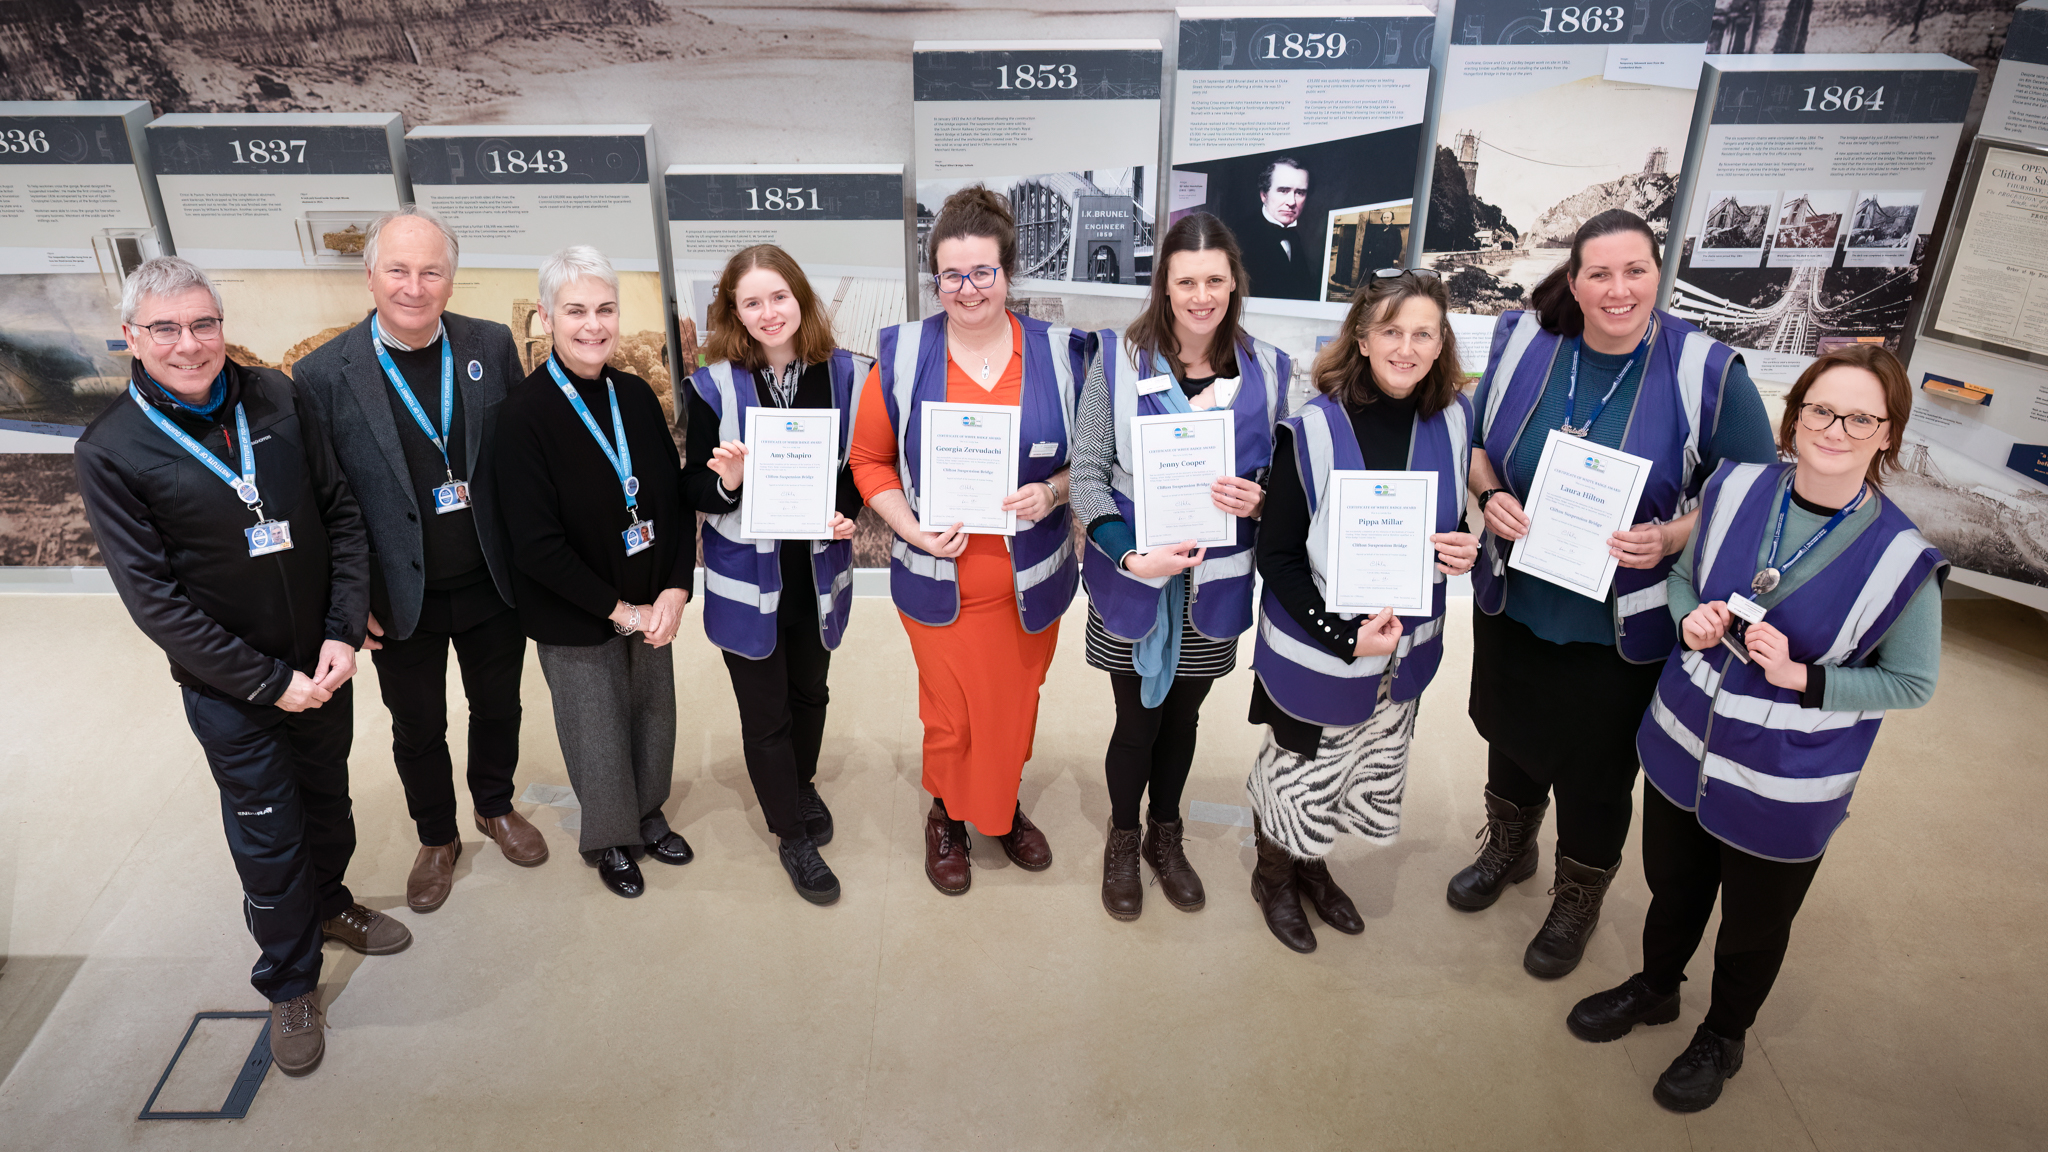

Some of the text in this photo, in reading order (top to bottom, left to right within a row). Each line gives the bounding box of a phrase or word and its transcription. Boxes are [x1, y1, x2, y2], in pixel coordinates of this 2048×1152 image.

[1537, 6, 1626, 33] 1863
[1261, 32, 1348, 59] 1859
[996, 64, 1078, 90] 1853
[1798, 86, 1884, 111] 1864
[228, 139, 307, 164] 1837
[487, 149, 570, 174] 1843
[1992, 168, 2027, 182] Clifton
[746, 187, 824, 212] 1851
[389, 368, 403, 388] GUIDING
[401, 387, 415, 407] TOURIST
[582, 411, 596, 430] GUIDING
[160, 419, 232, 478] INSTITUTE OF TOURIST GUIDING
[594, 429, 608, 448] TOURIST
[1159, 460, 1206, 469] Jenny Cooper
[1560, 484, 1605, 505] Laura Hilton
[1358, 518, 1379, 526] Pippa
